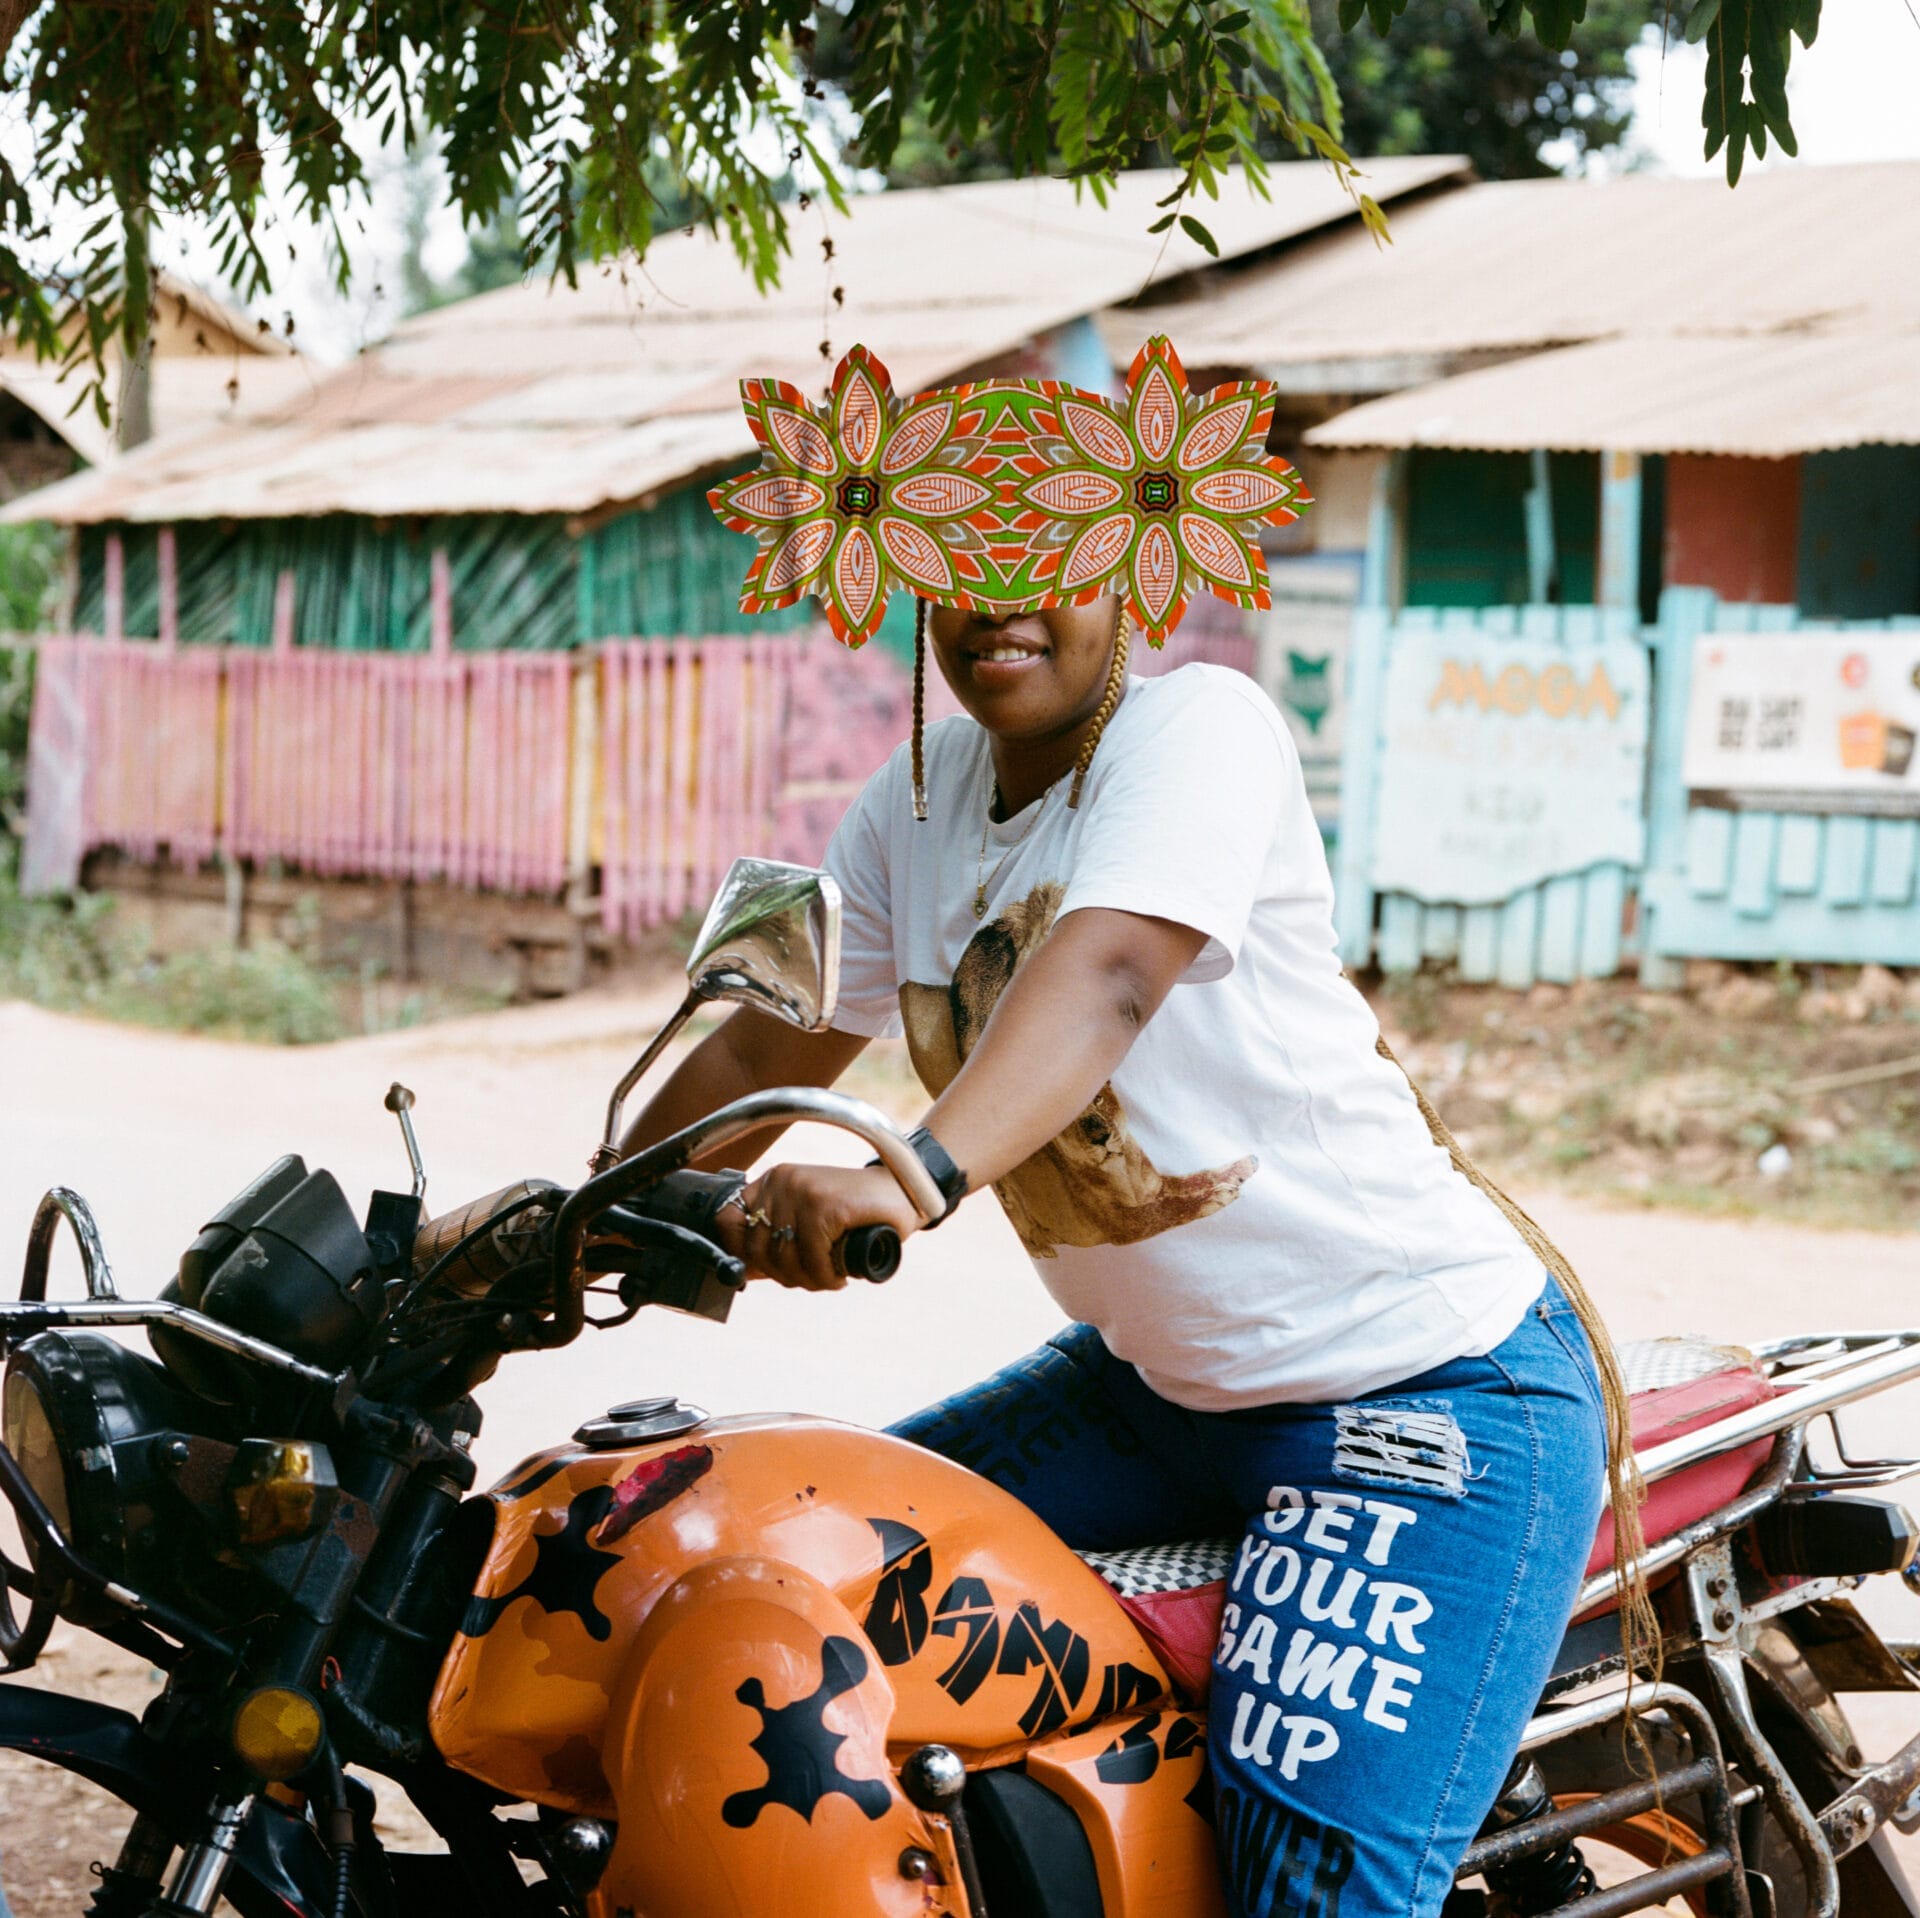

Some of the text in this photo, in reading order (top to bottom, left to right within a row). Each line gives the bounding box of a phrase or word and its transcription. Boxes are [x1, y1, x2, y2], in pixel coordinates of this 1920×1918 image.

[1263, 1485, 1418, 1566] GET
[1231, 1533, 1434, 1654] YOUR
[1217, 1602, 1422, 1732] GAME
[1229, 1691, 1341, 1781] UP
